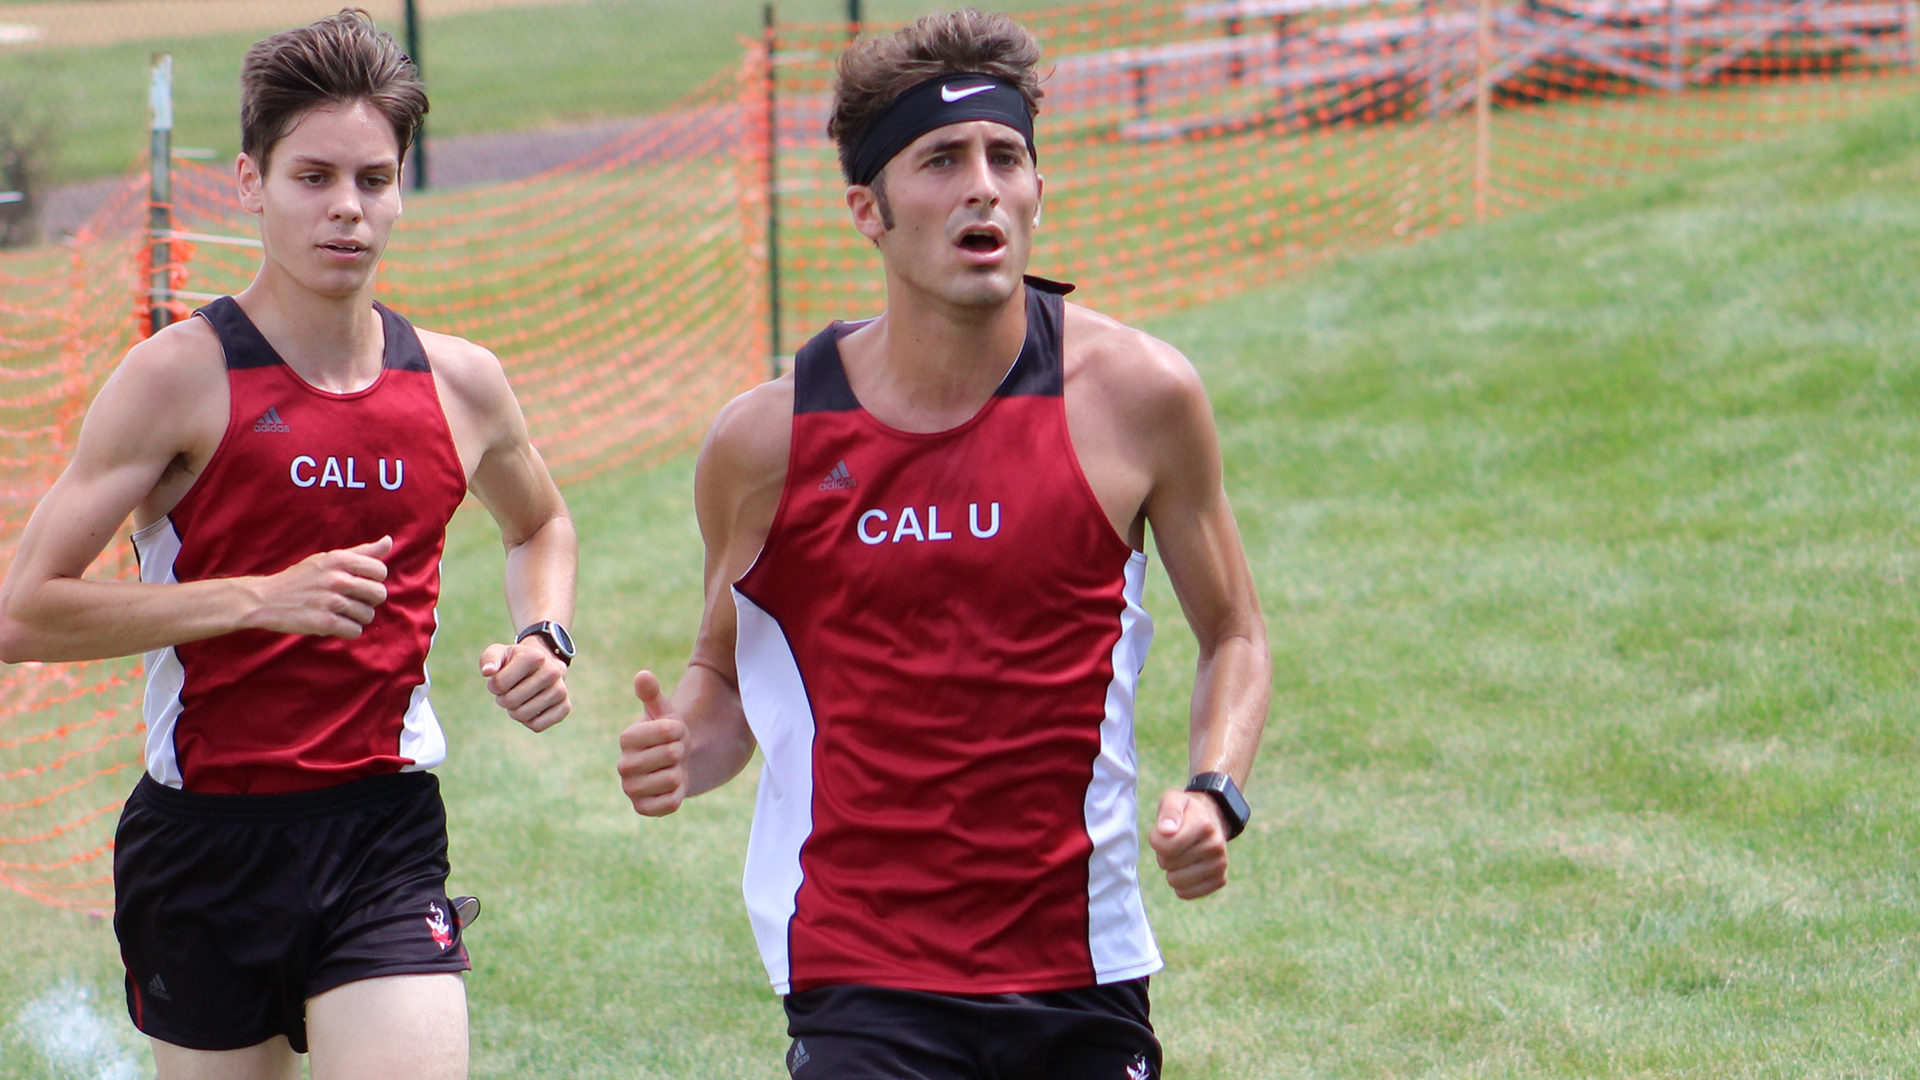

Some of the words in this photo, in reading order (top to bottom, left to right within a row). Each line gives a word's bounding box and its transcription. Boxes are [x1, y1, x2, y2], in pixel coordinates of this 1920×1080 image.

[253, 423, 290, 433] adidas
[290, 455, 367, 489] CAL
[378, 458, 404, 490] U
[818, 477, 857, 491] adidas
[857, 505, 953, 545] CAL
[968, 502, 1001, 539] U
